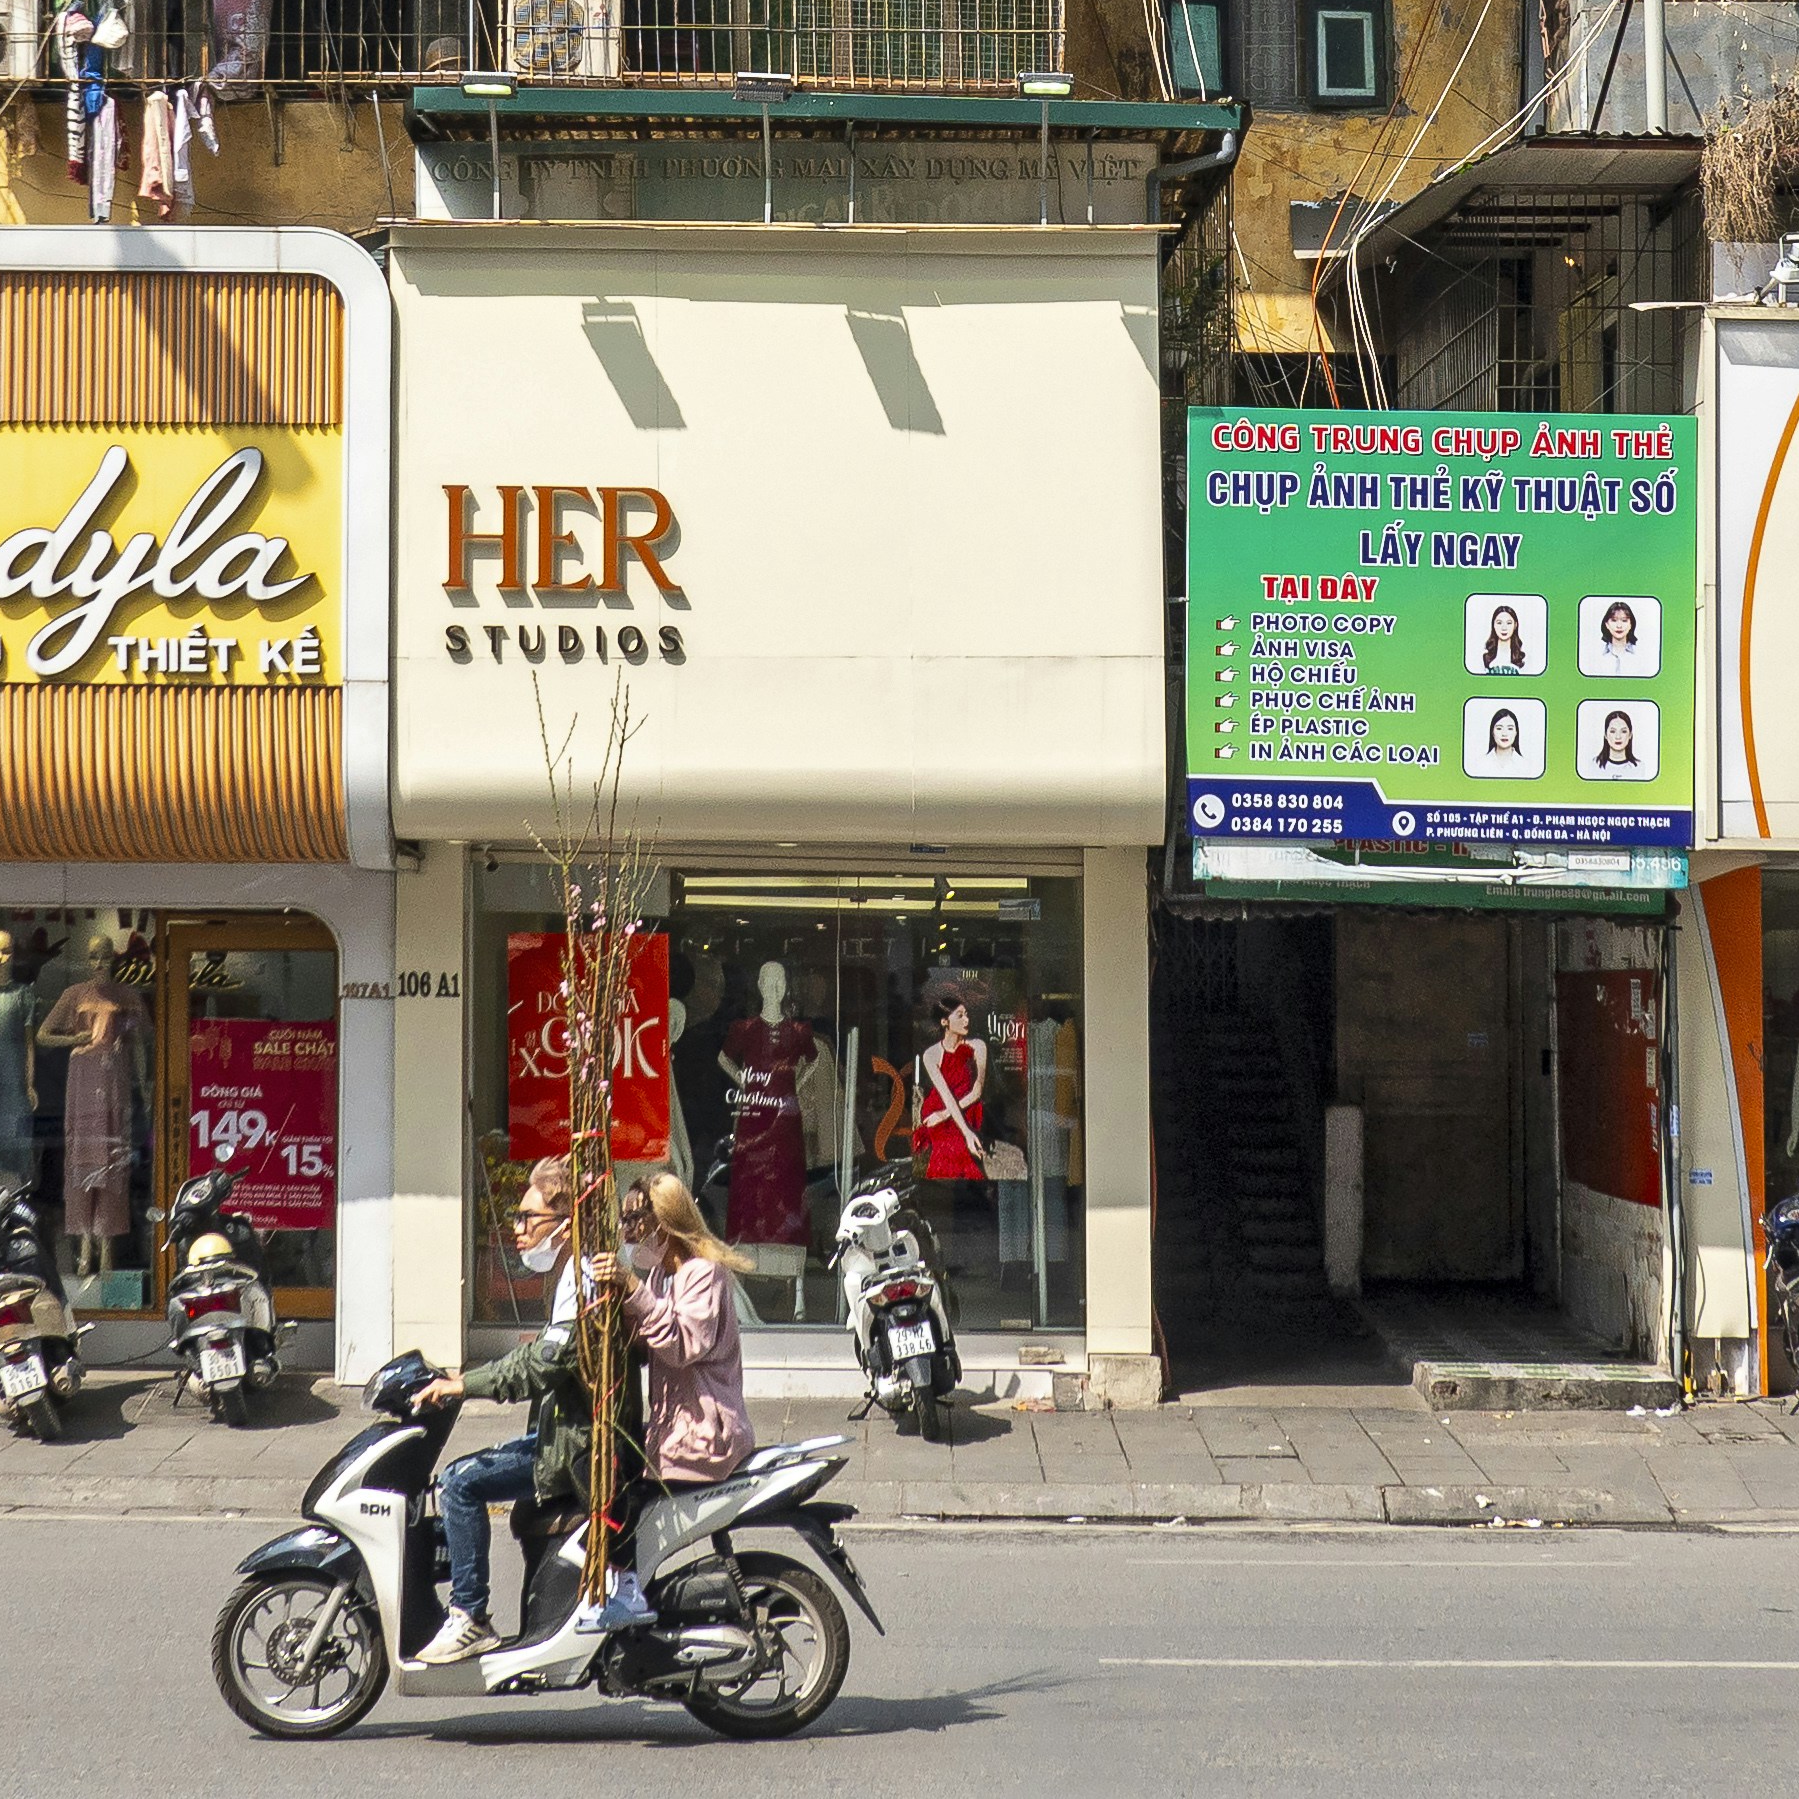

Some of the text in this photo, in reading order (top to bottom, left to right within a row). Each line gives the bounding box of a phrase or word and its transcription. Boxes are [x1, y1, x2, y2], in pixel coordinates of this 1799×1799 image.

[860, 151, 917, 181] XÂY
[926, 156, 1010, 186] DỰNG
[1212, 417, 1674, 462] CÔNG TRUNG CHỤP ẢNH THẺ
[1207, 461, 1679, 521] CHỤP ẢNH THẺ KỸ THUẬT SỐ
[441, 484, 682, 591] HER
[1360, 520, 1523, 569] LẤY NGAY
[1261, 572, 1380, 605] TẠI ĐÂY
[1251, 613, 1397, 635] PHOTO COPY
[108, 622, 239, 674] THIẾT
[259, 624, 322, 676] KẾ
[445, 625, 685, 655] STUDIOS
[1250, 633, 1355, 659] ẢNH VISA
[1251, 661, 1357, 688] HỘ CHIẾU
[1251, 687, 1416, 714] PHỤC CHẾ ẢNH
[1251, 712, 1369, 737] ÉP PLASTIC
[1250, 738, 1440, 768] IN ẢNH CÁC LOẠI
[1231, 793, 1344, 810] 0358 830 804
[1231, 817, 1343, 834] 0384 170 255
[1426, 809, 1441, 823] SỐ
[1443, 813, 1462, 825] 105
[1468, 811, 1489, 826] TẬP
[1511, 814, 1524, 825] A1
[1545, 815, 1575, 829] PHẠM
[1577, 815, 1606, 830] NGỌC
[1607, 816, 1635, 830] NGỌC
[1637, 816, 1671, 831] THẠCH
[1426, 827, 1435, 838] P.
[1511, 829, 1523, 840] Q.
[1576, 828, 1591, 841] HÀ
[1592, 829, 1611, 843] NỘI
[1486, 885, 1521, 897] Email:
[397, 970, 461, 999] 106 A1
[253, 1041, 292, 1056] SALE
[741, 1065, 773, 1087] Merry
[725, 1088, 791, 1108] Christmas
[281, 1144, 335, 1178] 15%
